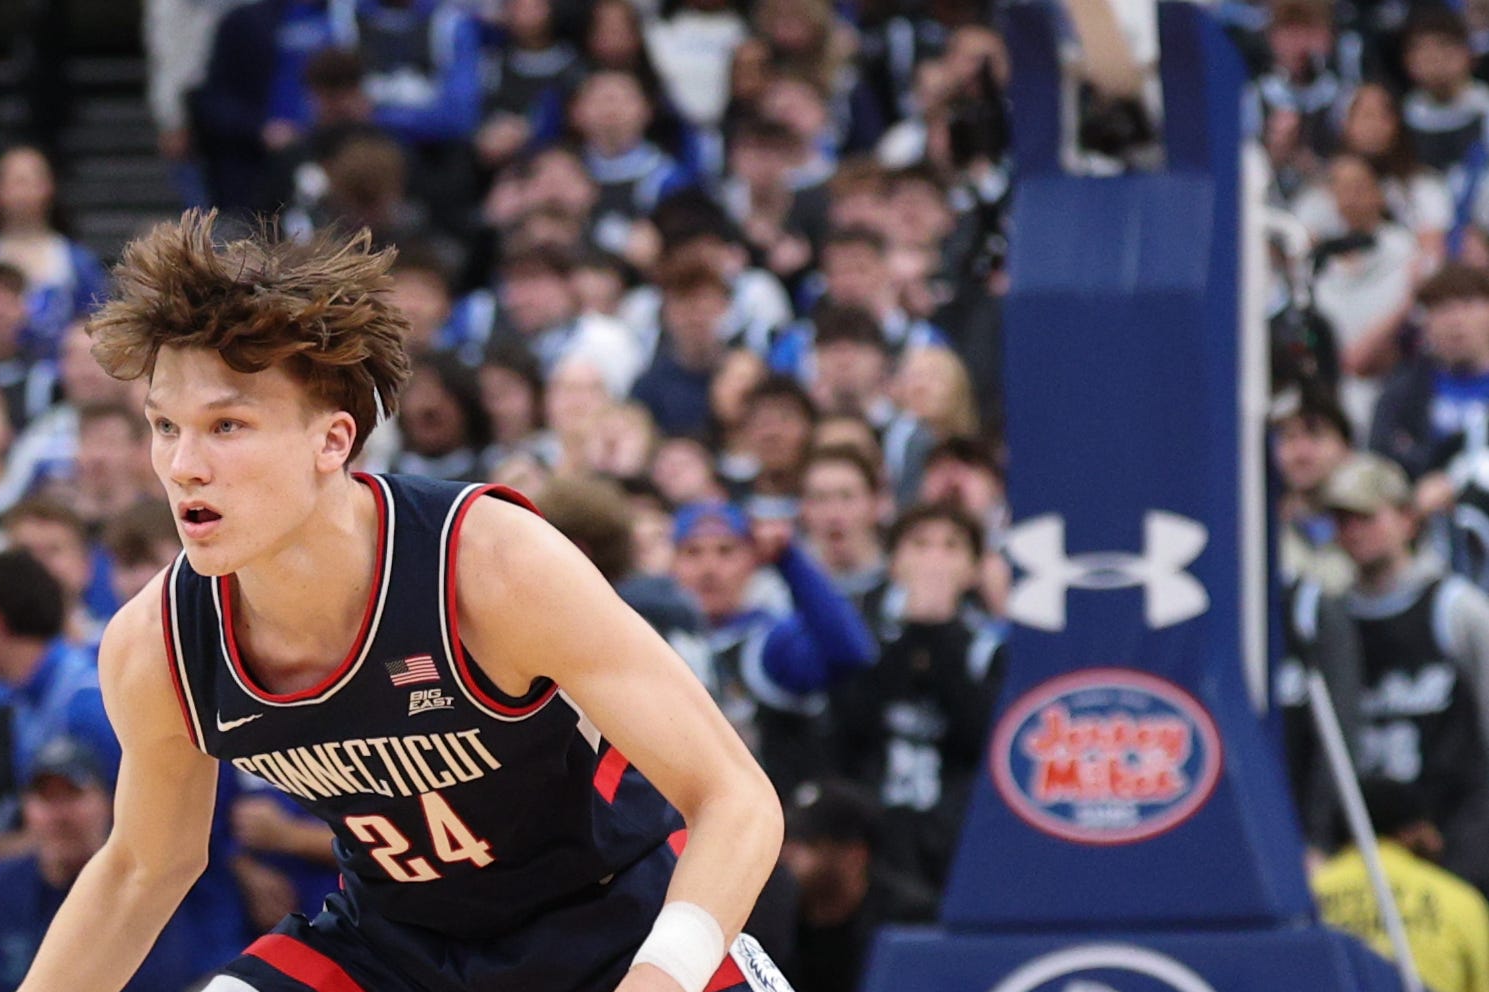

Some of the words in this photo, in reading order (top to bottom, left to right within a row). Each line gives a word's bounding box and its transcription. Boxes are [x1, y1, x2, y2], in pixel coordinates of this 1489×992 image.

[410, 688, 442, 701] BIG
[408, 696, 455, 711] EAST
[343, 789, 496, 883] 24
